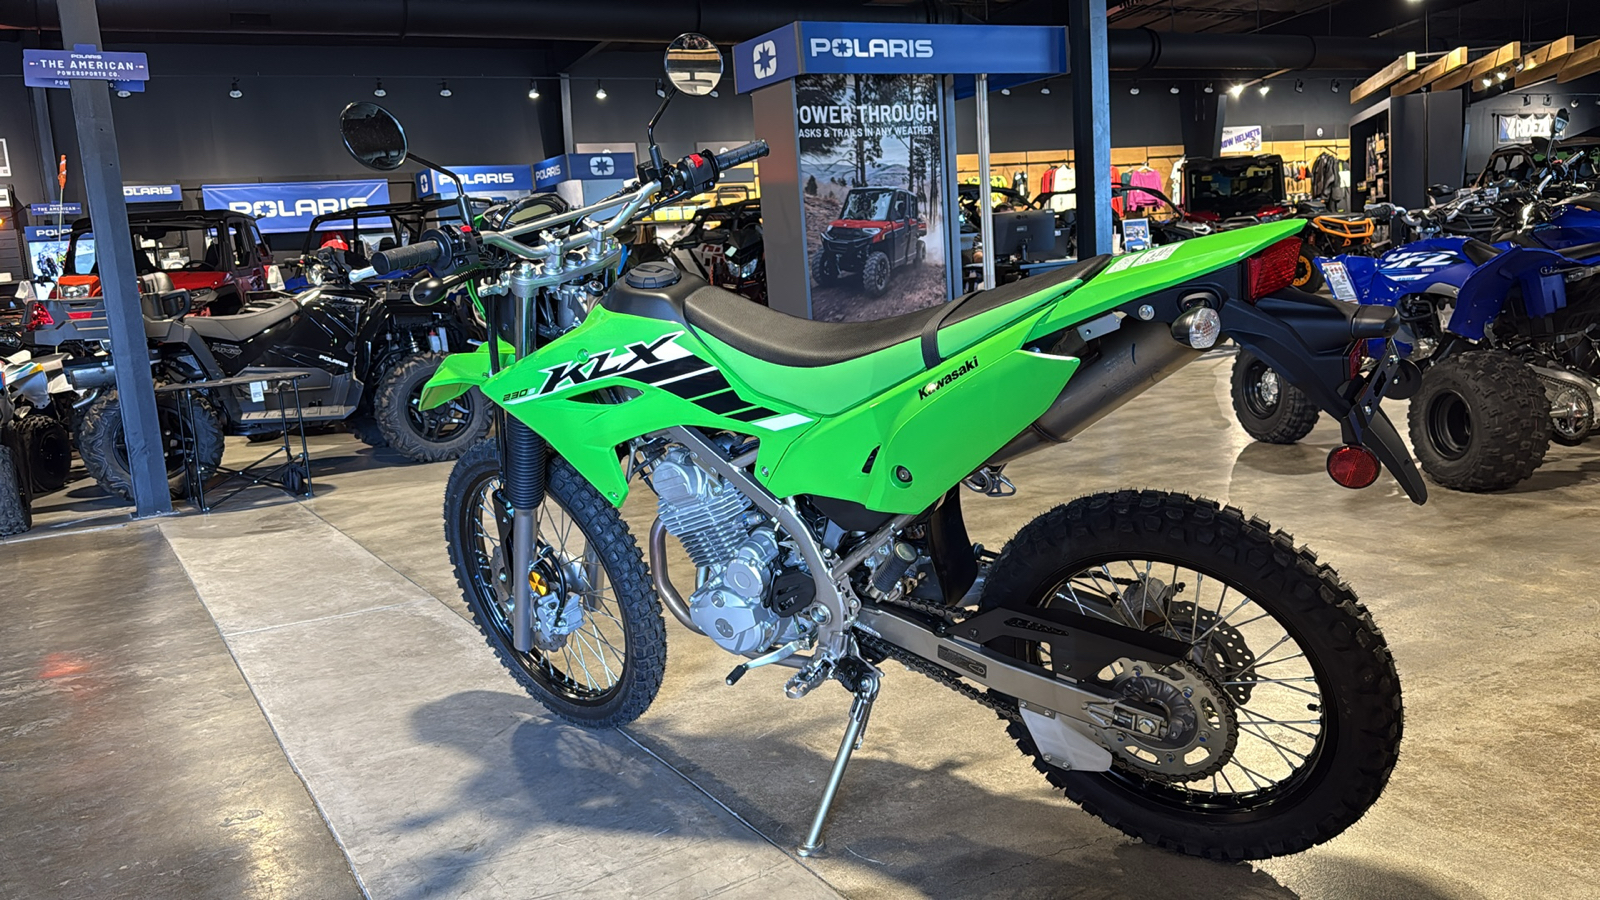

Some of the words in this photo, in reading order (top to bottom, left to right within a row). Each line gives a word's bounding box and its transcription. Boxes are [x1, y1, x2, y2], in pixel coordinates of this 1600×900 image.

[810, 38, 934, 58] POLARIS
[40, 60, 65, 69] THE
[70, 61, 134, 71] AMERICAN
[797, 105, 853, 124] OWER
[857, 104, 937, 123] THROUGH
[798, 128, 822, 138] ASKS
[823, 129, 830, 138] &
[833, 128, 863, 138] TRAILS
[865, 127, 874, 137] IN
[875, 127, 892, 137] ANY
[894, 126, 934, 136] WEATHER
[1234, 128, 1261, 144] HELMETS
[535, 164, 561, 181] POLARIS
[123, 187, 173, 196] OLARIS
[229, 197, 369, 218] POLARIS
[319, 354, 349, 368] POLARIS
[541, 331, 685, 395] KLX
